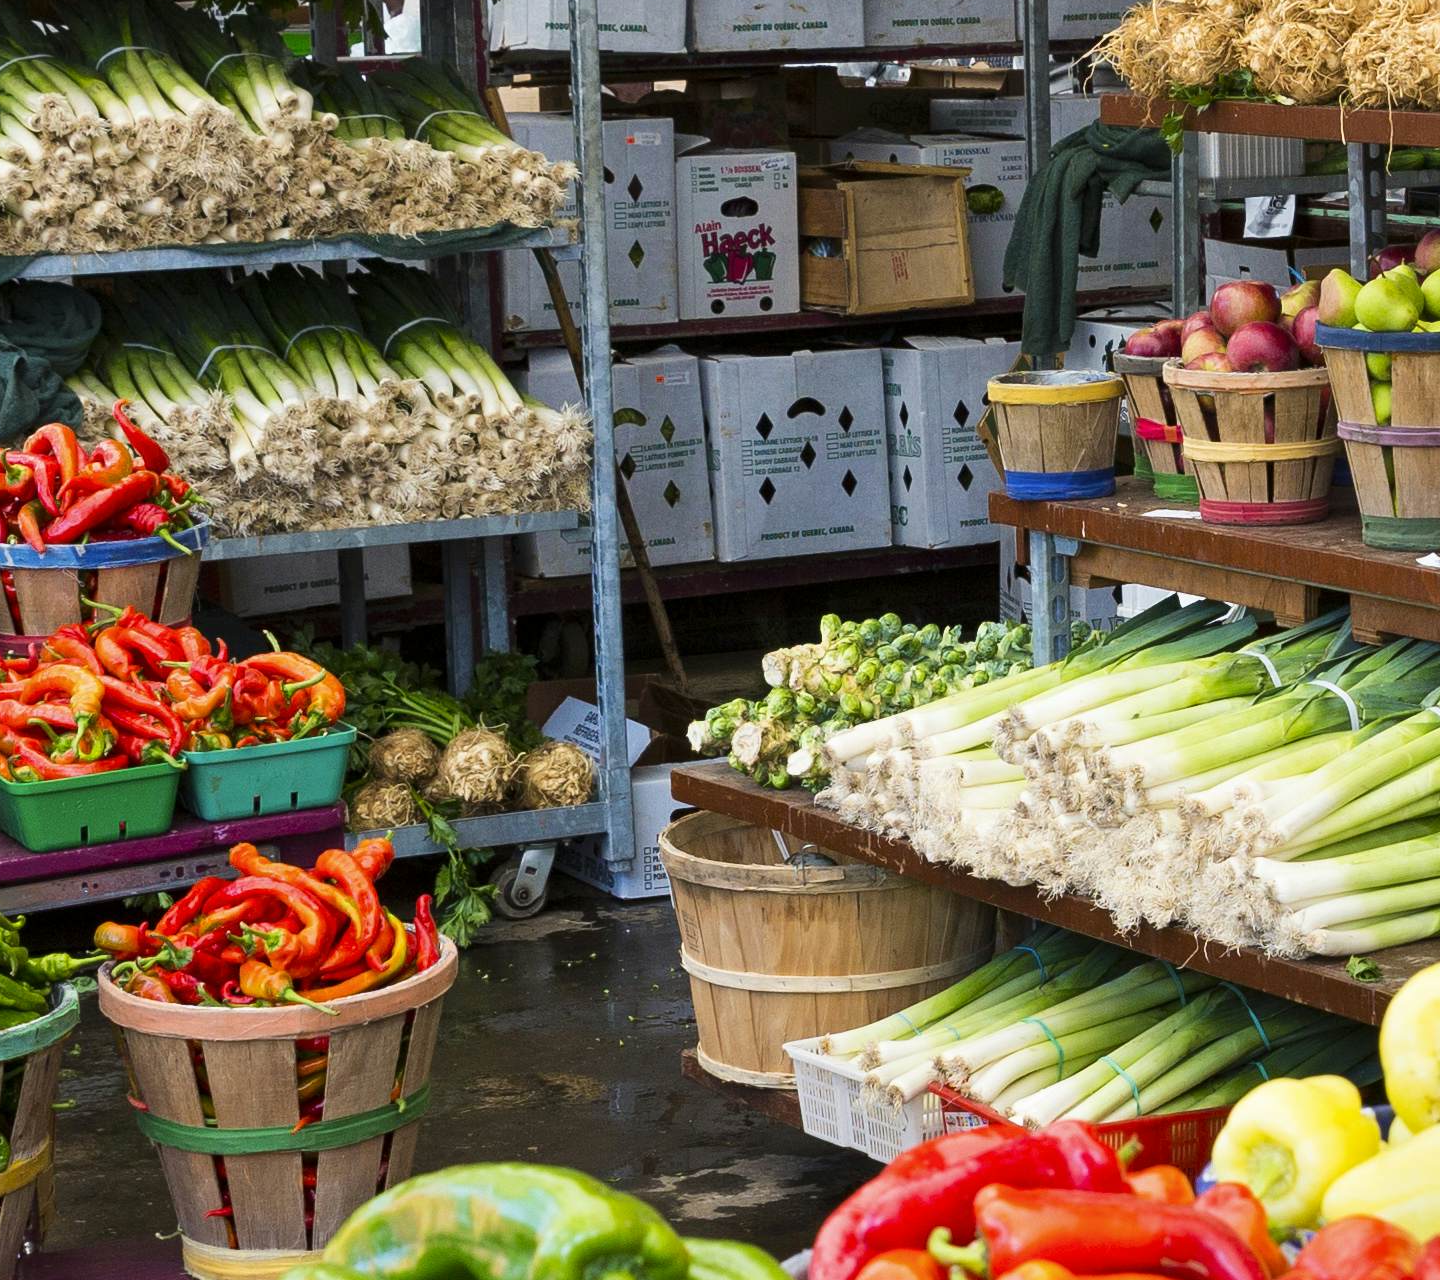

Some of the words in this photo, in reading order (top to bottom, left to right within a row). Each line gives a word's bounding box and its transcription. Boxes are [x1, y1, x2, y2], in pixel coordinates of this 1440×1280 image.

[733, 23, 762, 32] PRODUIT
[763, 22, 773, 31] DU
[802, 21, 828, 30] CANADA
[694, 220, 722, 234] Alain
[700, 223, 776, 258] Haeck
[760, 531, 790, 541] PRODUCT
[791, 530, 800, 539] OF
[829, 525, 855, 535] CANADA
